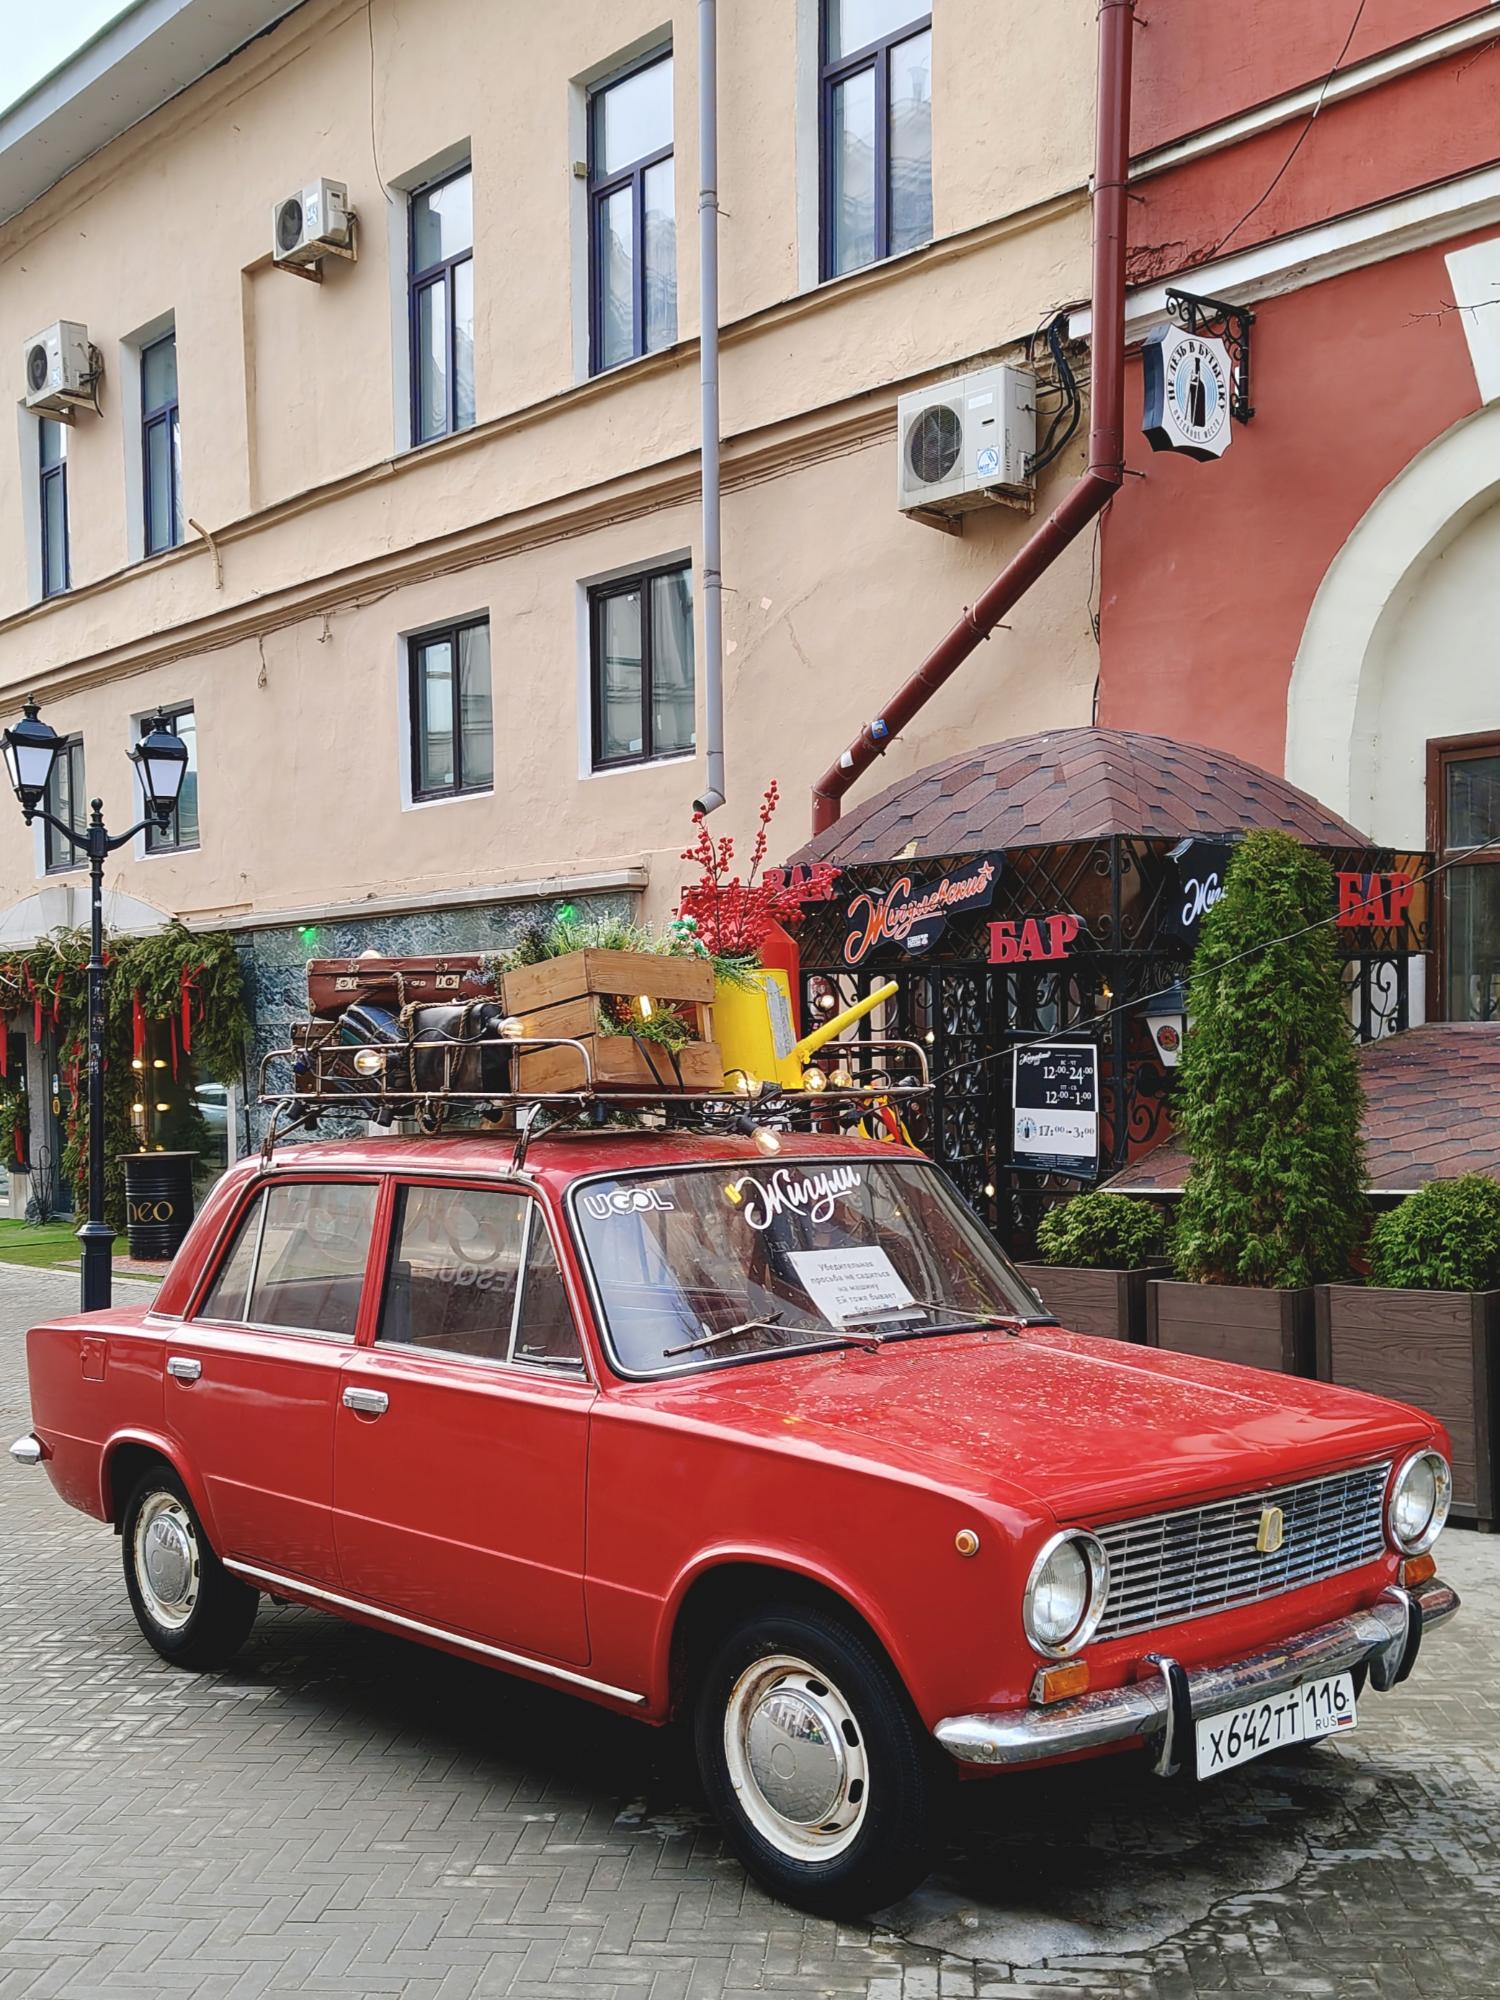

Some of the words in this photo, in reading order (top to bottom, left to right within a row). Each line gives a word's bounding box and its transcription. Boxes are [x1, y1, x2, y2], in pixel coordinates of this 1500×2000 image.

[1170, 345, 1187, 376] ЛЕЗЬ
[1189, 341, 1196, 353] В
[1198, 343, 1226, 412] БУТЫЛКУ
[1334, 871, 1415, 927] БАР
[987, 914, 1079, 964] БАР
[584, 1188, 674, 1220] UGOL
[735, 1165, 862, 1230] Жигули
[1306, 1679, 1347, 1718] 116
[1315, 1716, 1337, 1731] RUS
